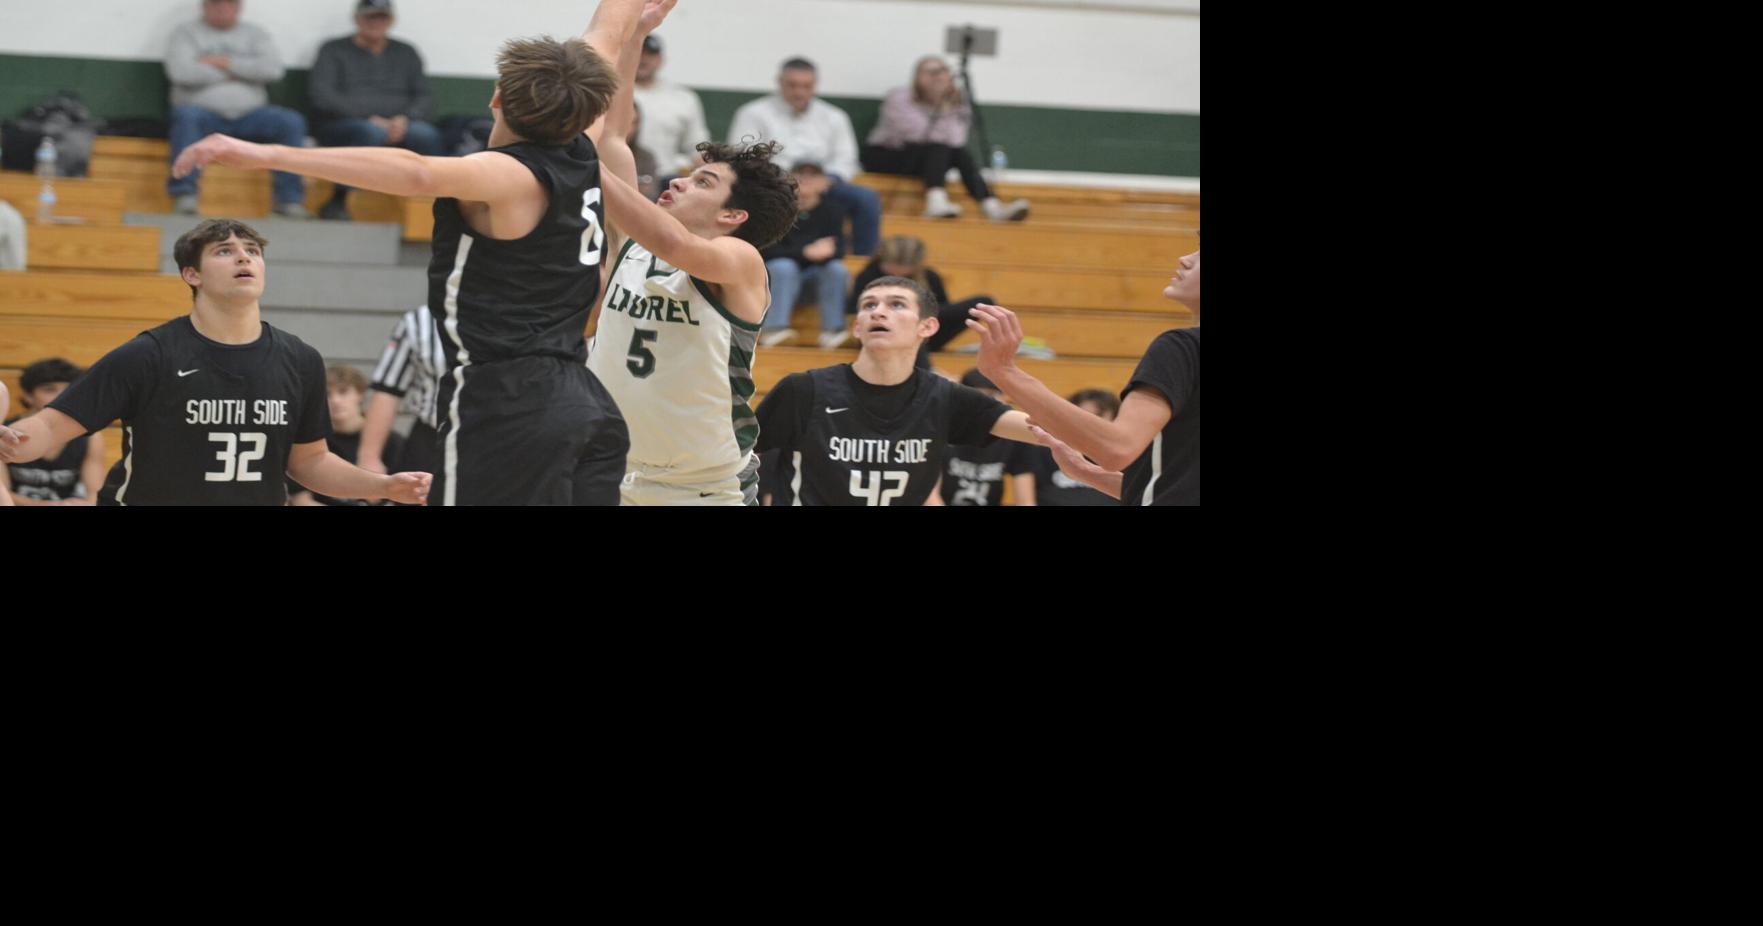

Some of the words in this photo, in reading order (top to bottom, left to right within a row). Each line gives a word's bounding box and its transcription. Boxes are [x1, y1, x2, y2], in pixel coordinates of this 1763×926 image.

[607, 283, 700, 326] LAUREL
[626, 327, 658, 379] 5
[185, 399, 246, 425] SOUTH
[253, 399, 289, 425] SIDE
[204, 431, 268, 482] 32
[828, 436, 890, 463] SOUTH
[894, 438, 933, 463] SIDE
[849, 469, 910, 506] 42
